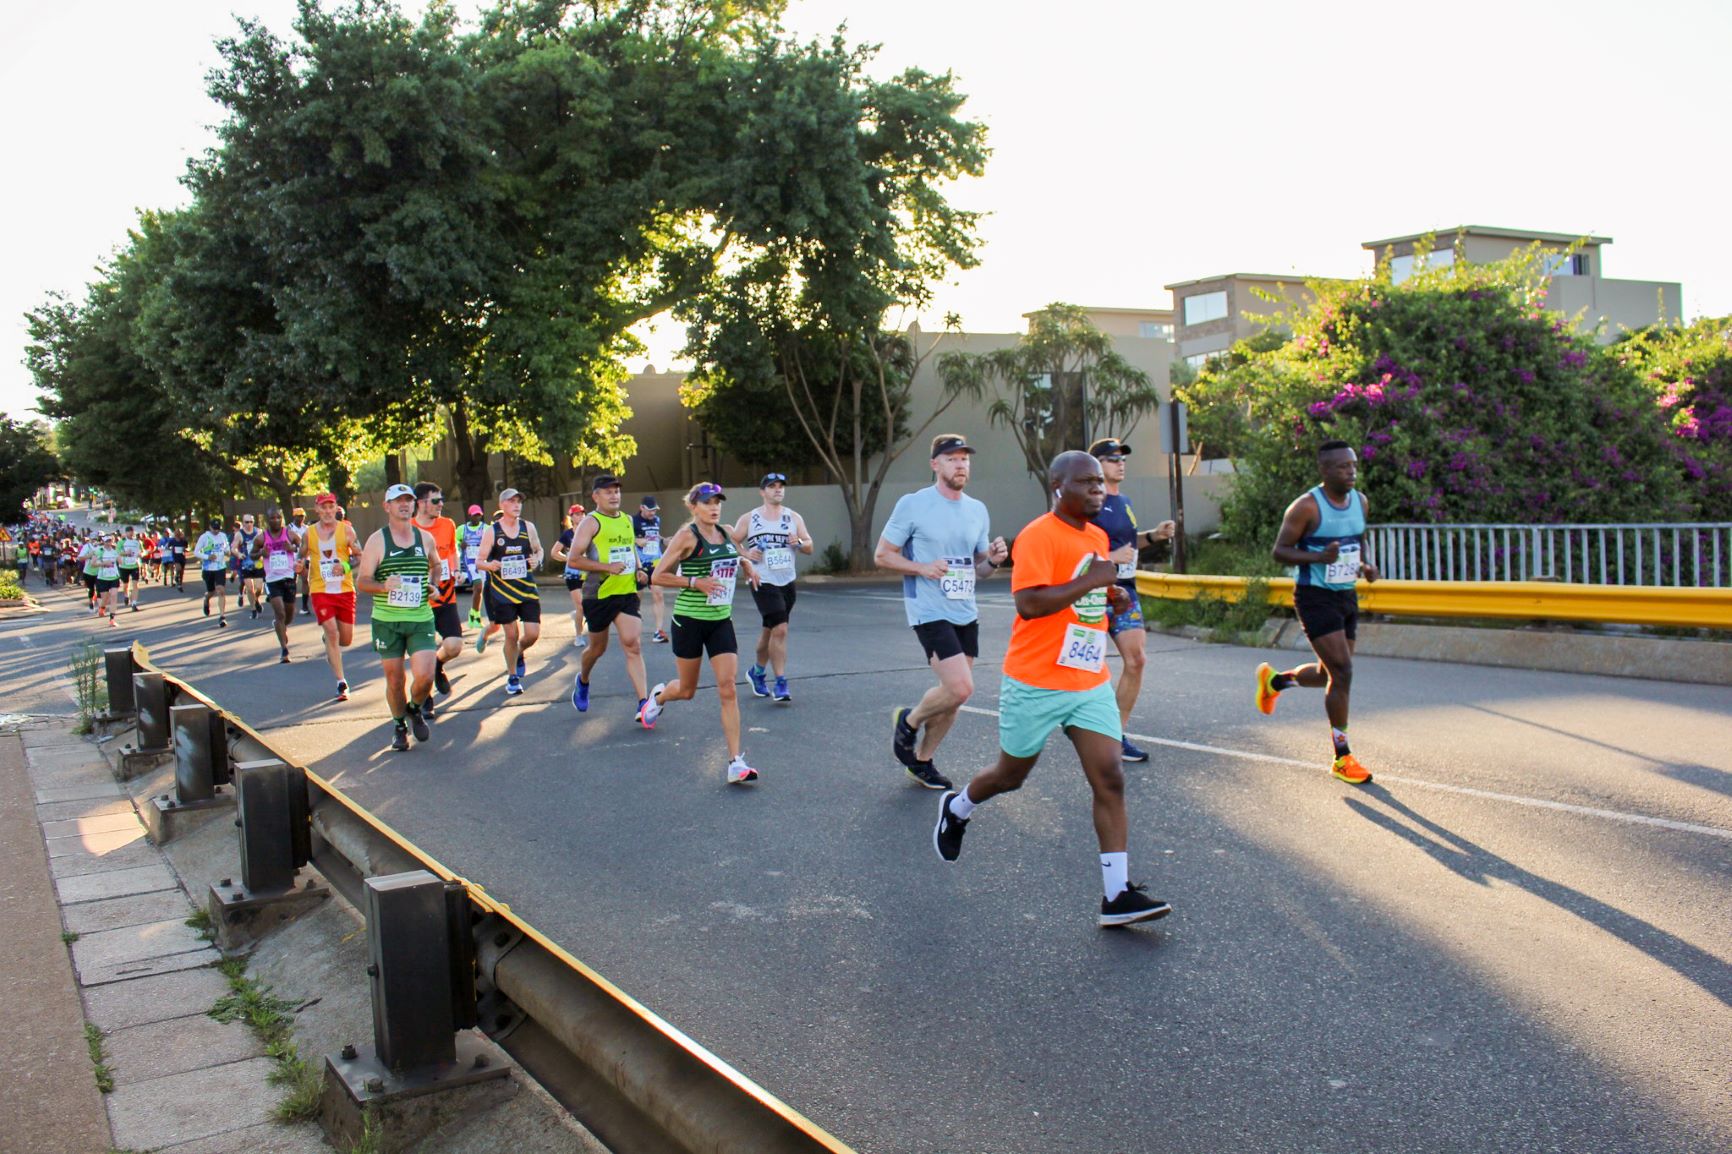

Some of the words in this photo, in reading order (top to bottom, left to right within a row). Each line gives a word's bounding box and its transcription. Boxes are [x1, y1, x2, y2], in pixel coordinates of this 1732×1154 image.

[768, 554, 791, 566] B5644
[390, 590, 420, 602] B2139
[1069, 641, 1101, 662] 8464
